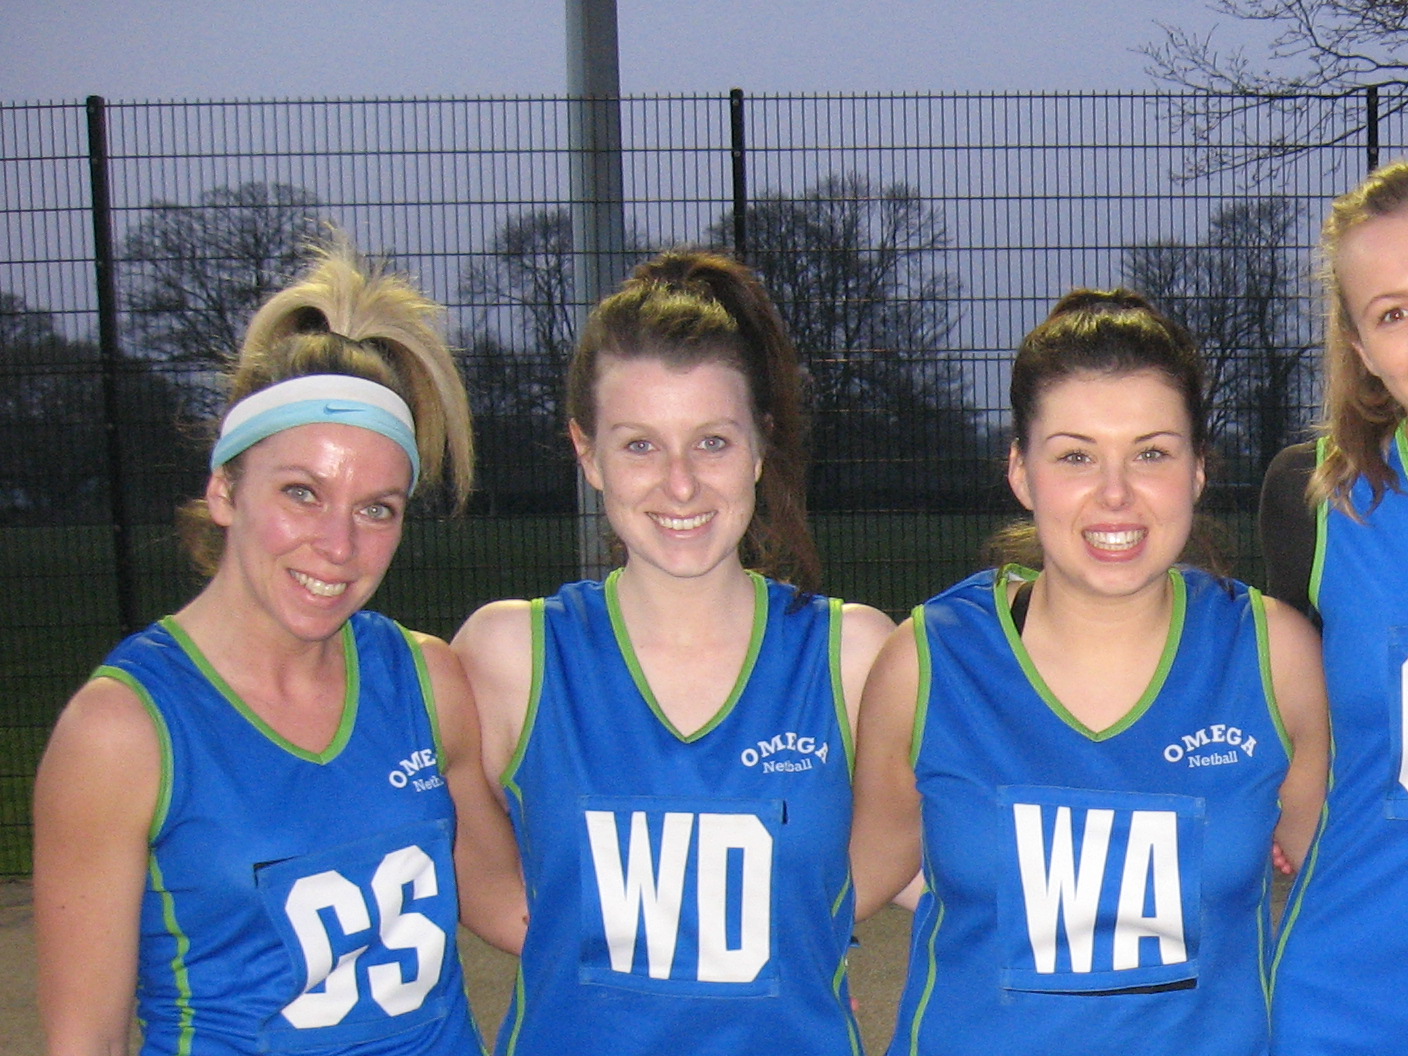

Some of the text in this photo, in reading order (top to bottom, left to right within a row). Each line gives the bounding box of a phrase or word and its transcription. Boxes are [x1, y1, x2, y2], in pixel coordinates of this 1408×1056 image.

[741, 732, 829, 767] OMEGA
[1163, 724, 1257, 763] OMEGA
[1187, 750, 1238, 768] Netball
[388, 748, 438, 789] OME
[584, 810, 773, 983] WD
[1013, 803, 1187, 974] WA
